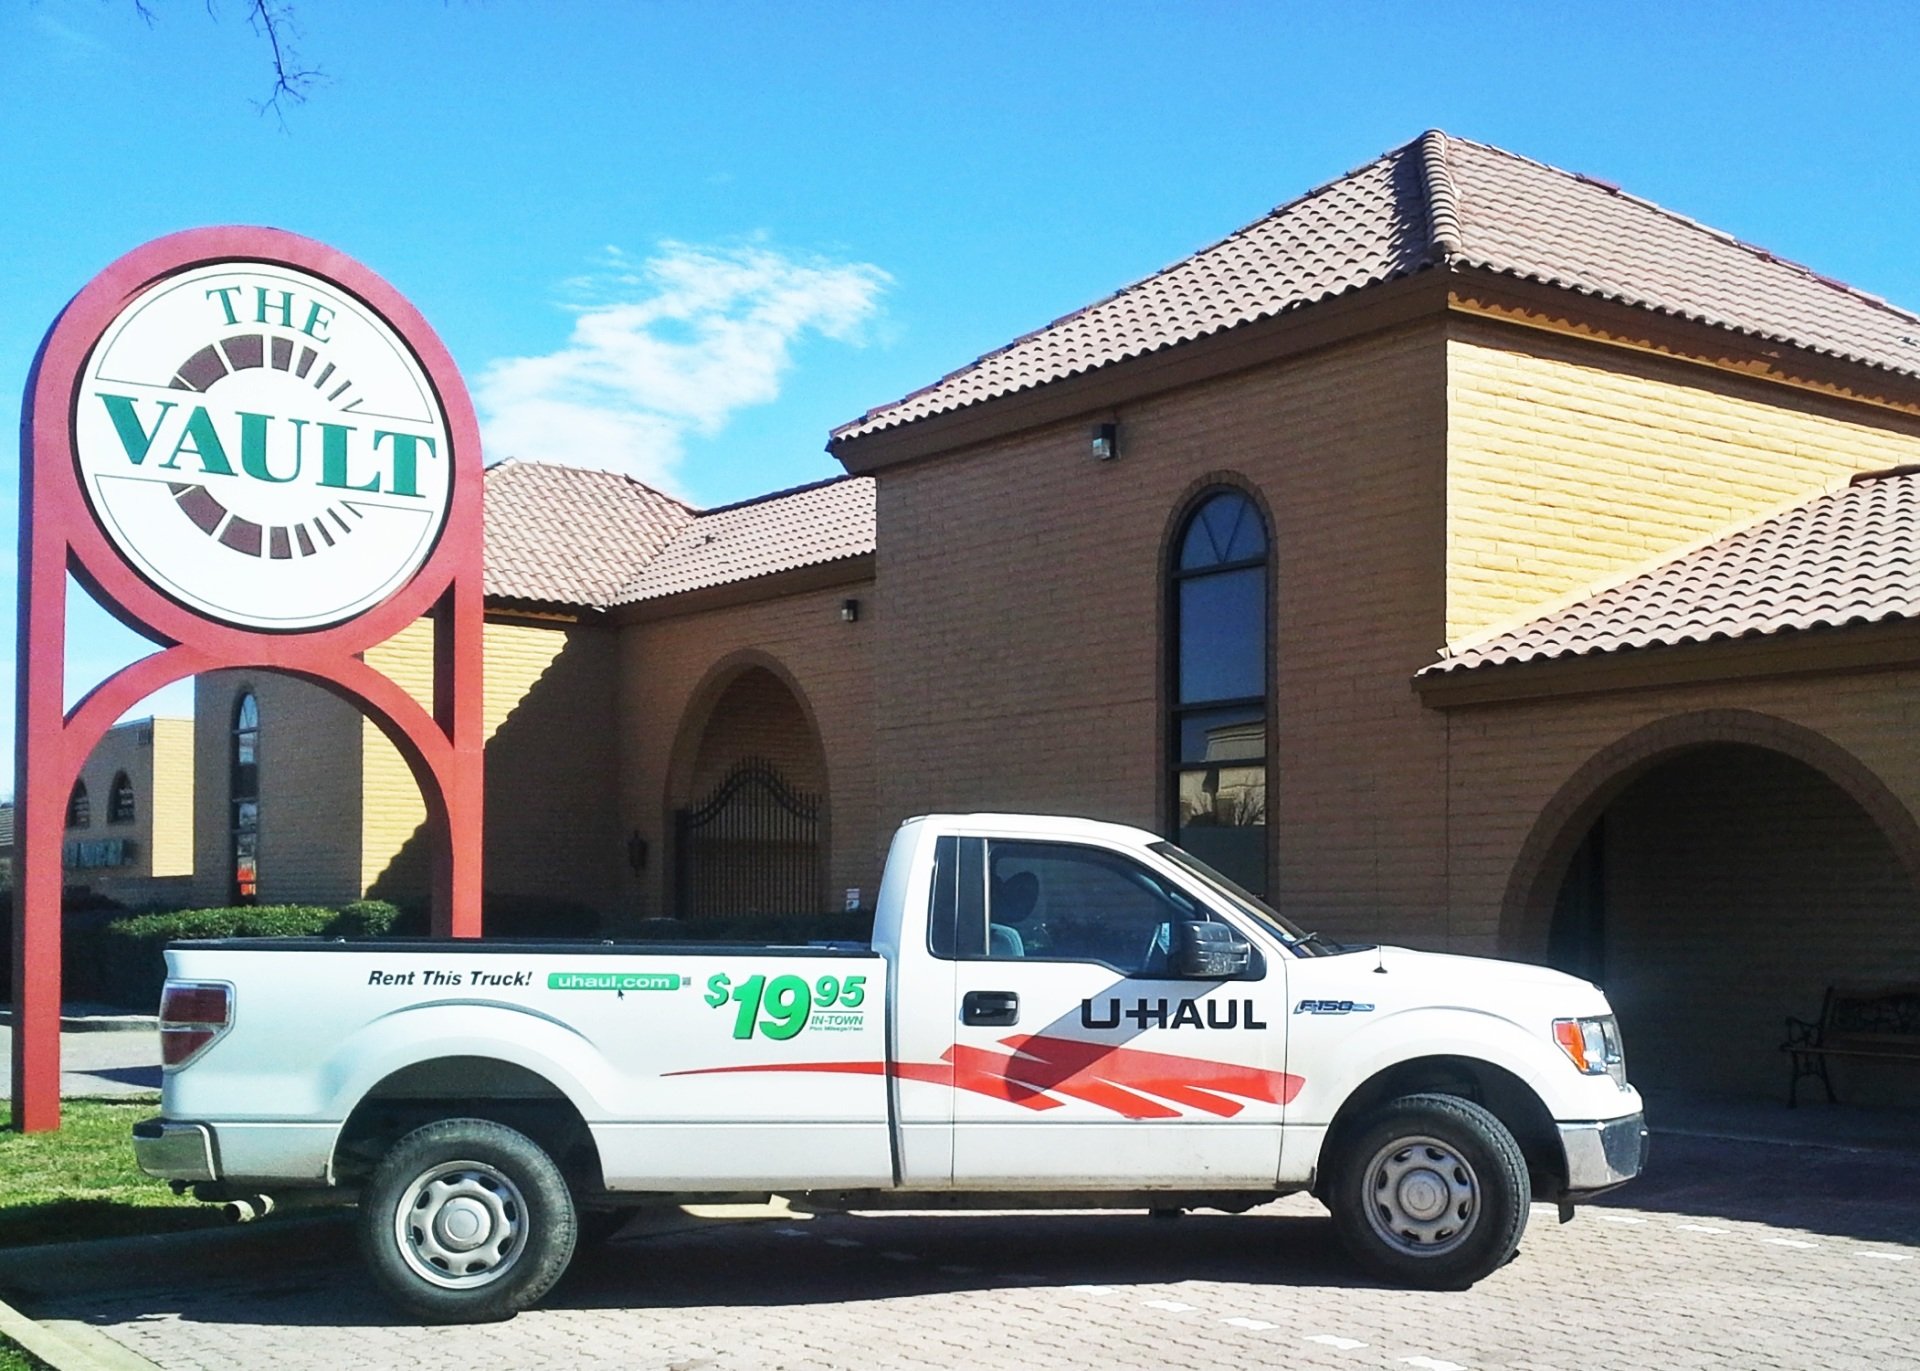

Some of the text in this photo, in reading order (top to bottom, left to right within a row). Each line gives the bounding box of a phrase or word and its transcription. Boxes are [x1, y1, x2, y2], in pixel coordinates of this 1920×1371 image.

[205, 285, 337, 344] THE
[94, 392, 437, 499] VAULT
[368, 970, 533, 986] Rent This Truck!
[558, 975, 671, 989] uhaul.com
[811, 1015, 864, 1026] IN-TOWN
[1081, 998, 1267, 1030] U-HAUL
